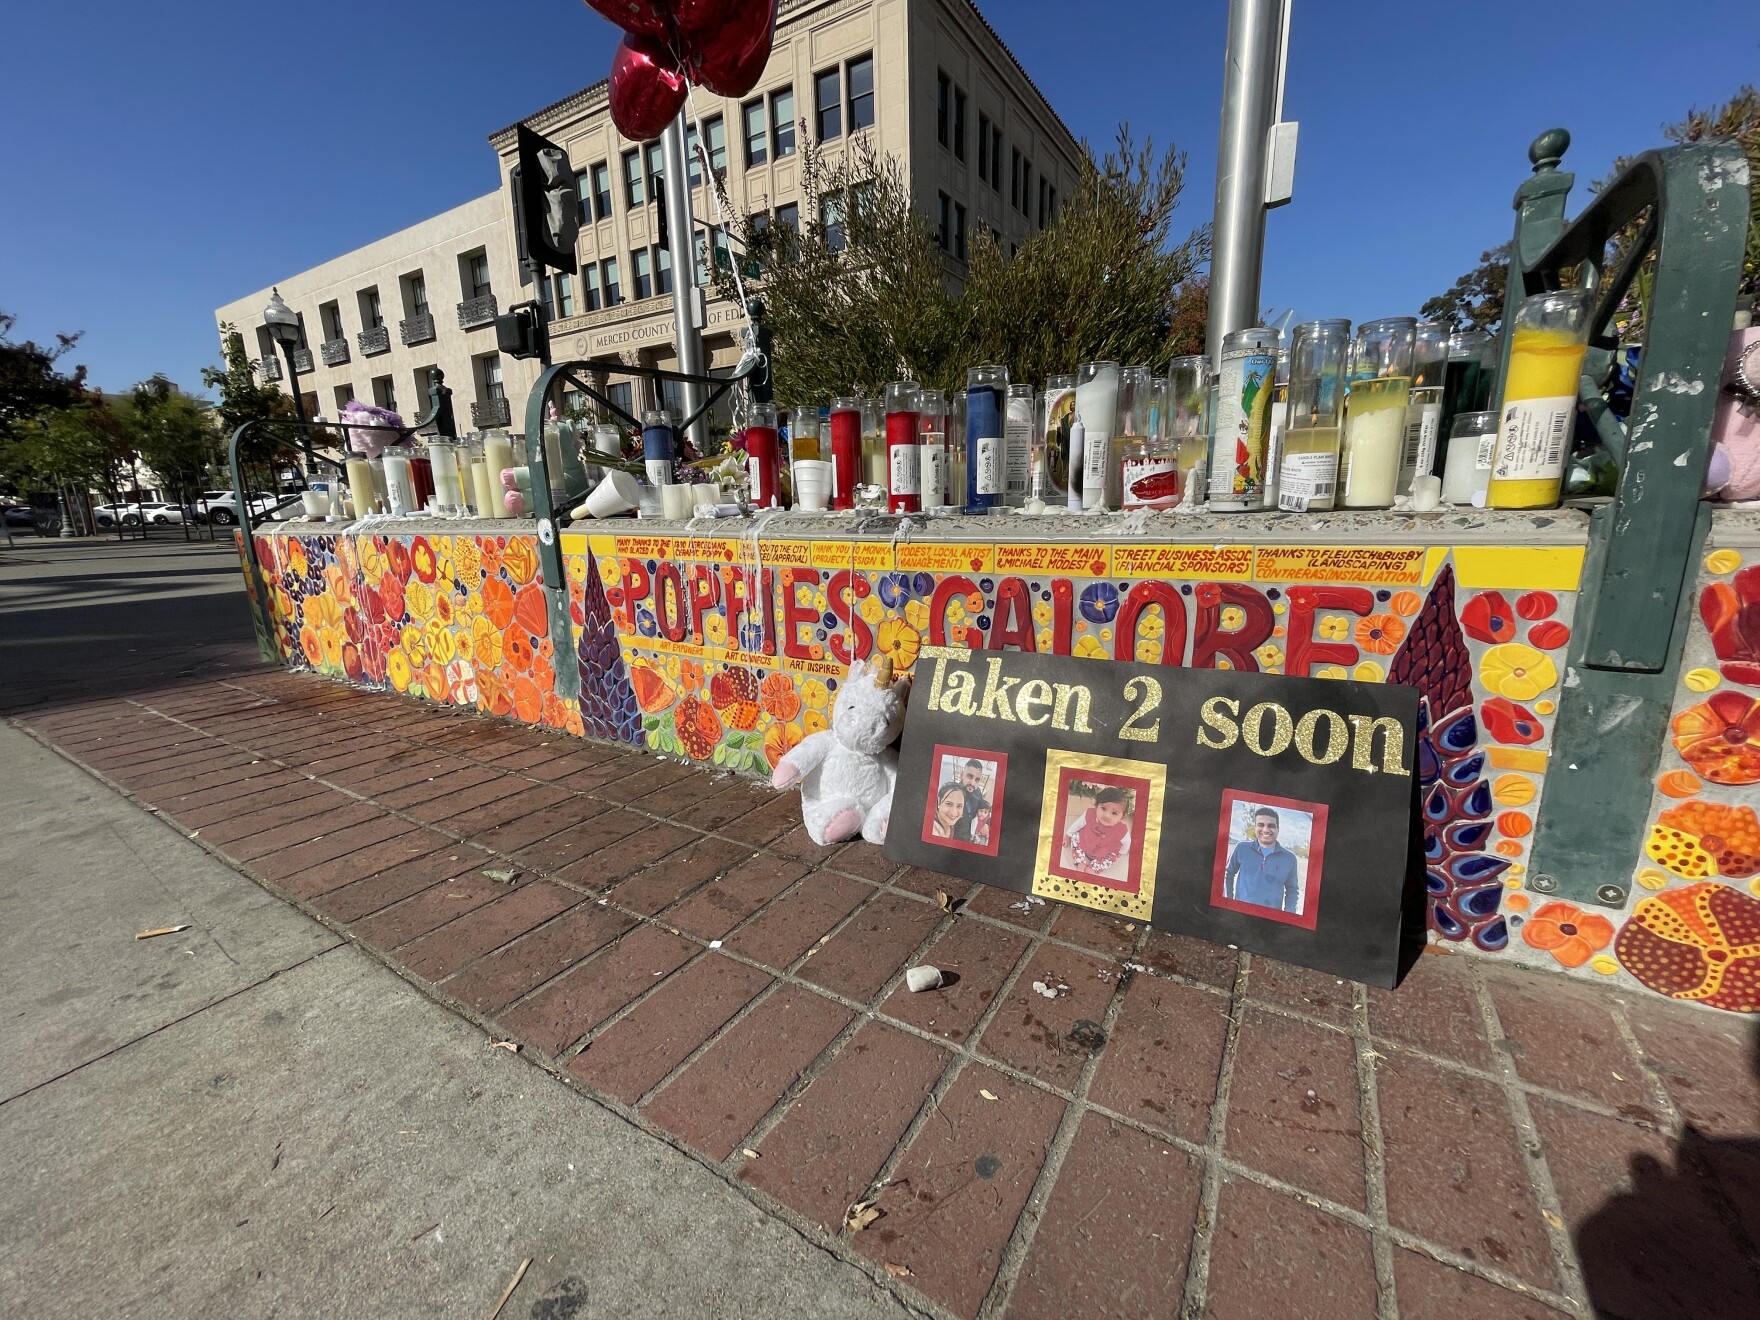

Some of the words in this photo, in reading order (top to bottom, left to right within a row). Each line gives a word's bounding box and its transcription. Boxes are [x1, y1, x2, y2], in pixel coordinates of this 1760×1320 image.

[596, 331, 630, 347] MERCED
[632, 322, 670, 340] COUNTY
[708, 311, 722, 324] OF
[617, 538, 631, 546] MANY
[632, 538, 651, 547] THANKS
[653, 539, 660, 547] TO
[661, 539, 671, 548] THE
[771, 544, 779, 553] TO
[780, 545, 792, 553] THE
[792, 545, 809, 554] CITY
[812, 544, 834, 554] THANK
[835, 544, 849, 554] YOU
[863, 545, 892, 555] MONIKA
[933, 547, 959, 557] LOCAL
[997, 547, 1033, 558] THANKS
[1036, 547, 1048, 559] TO
[1050, 548, 1070, 559] THE
[1072, 548, 1104, 560] MAIN
[1114, 549, 1157, 561] STREET
[1157, 549, 1215, 562] BUSINESS
[1256, 548, 1305, 559] THANKS
[1306, 549, 1320, 559] TO
[772, 553, 808, 564] (APPROVAL)
[812, 554, 845, 564] (PROJECT
[847, 555, 878, 566] DESIGN
[1256, 558, 1276, 568] ED
[1307, 558, 1407, 571] (LANDSCAPING)
[1047, 559, 1090, 571] MODEST
[1115, 561, 1175, 572] (FINANCIAL
[1178, 561, 1249, 574] SPONSORS)
[621, 558, 873, 666] POPPIES
[660, 641, 672, 650] ART
[672, 643, 704, 656] EMPOWERS
[724, 651, 740, 661] ART
[789, 659, 806, 671] ART
[807, 662, 841, 675] INSPIRES
[918, 644, 1094, 734] Taken
[1118, 675, 1163, 743] 2
[1196, 695, 1410, 776] soon
